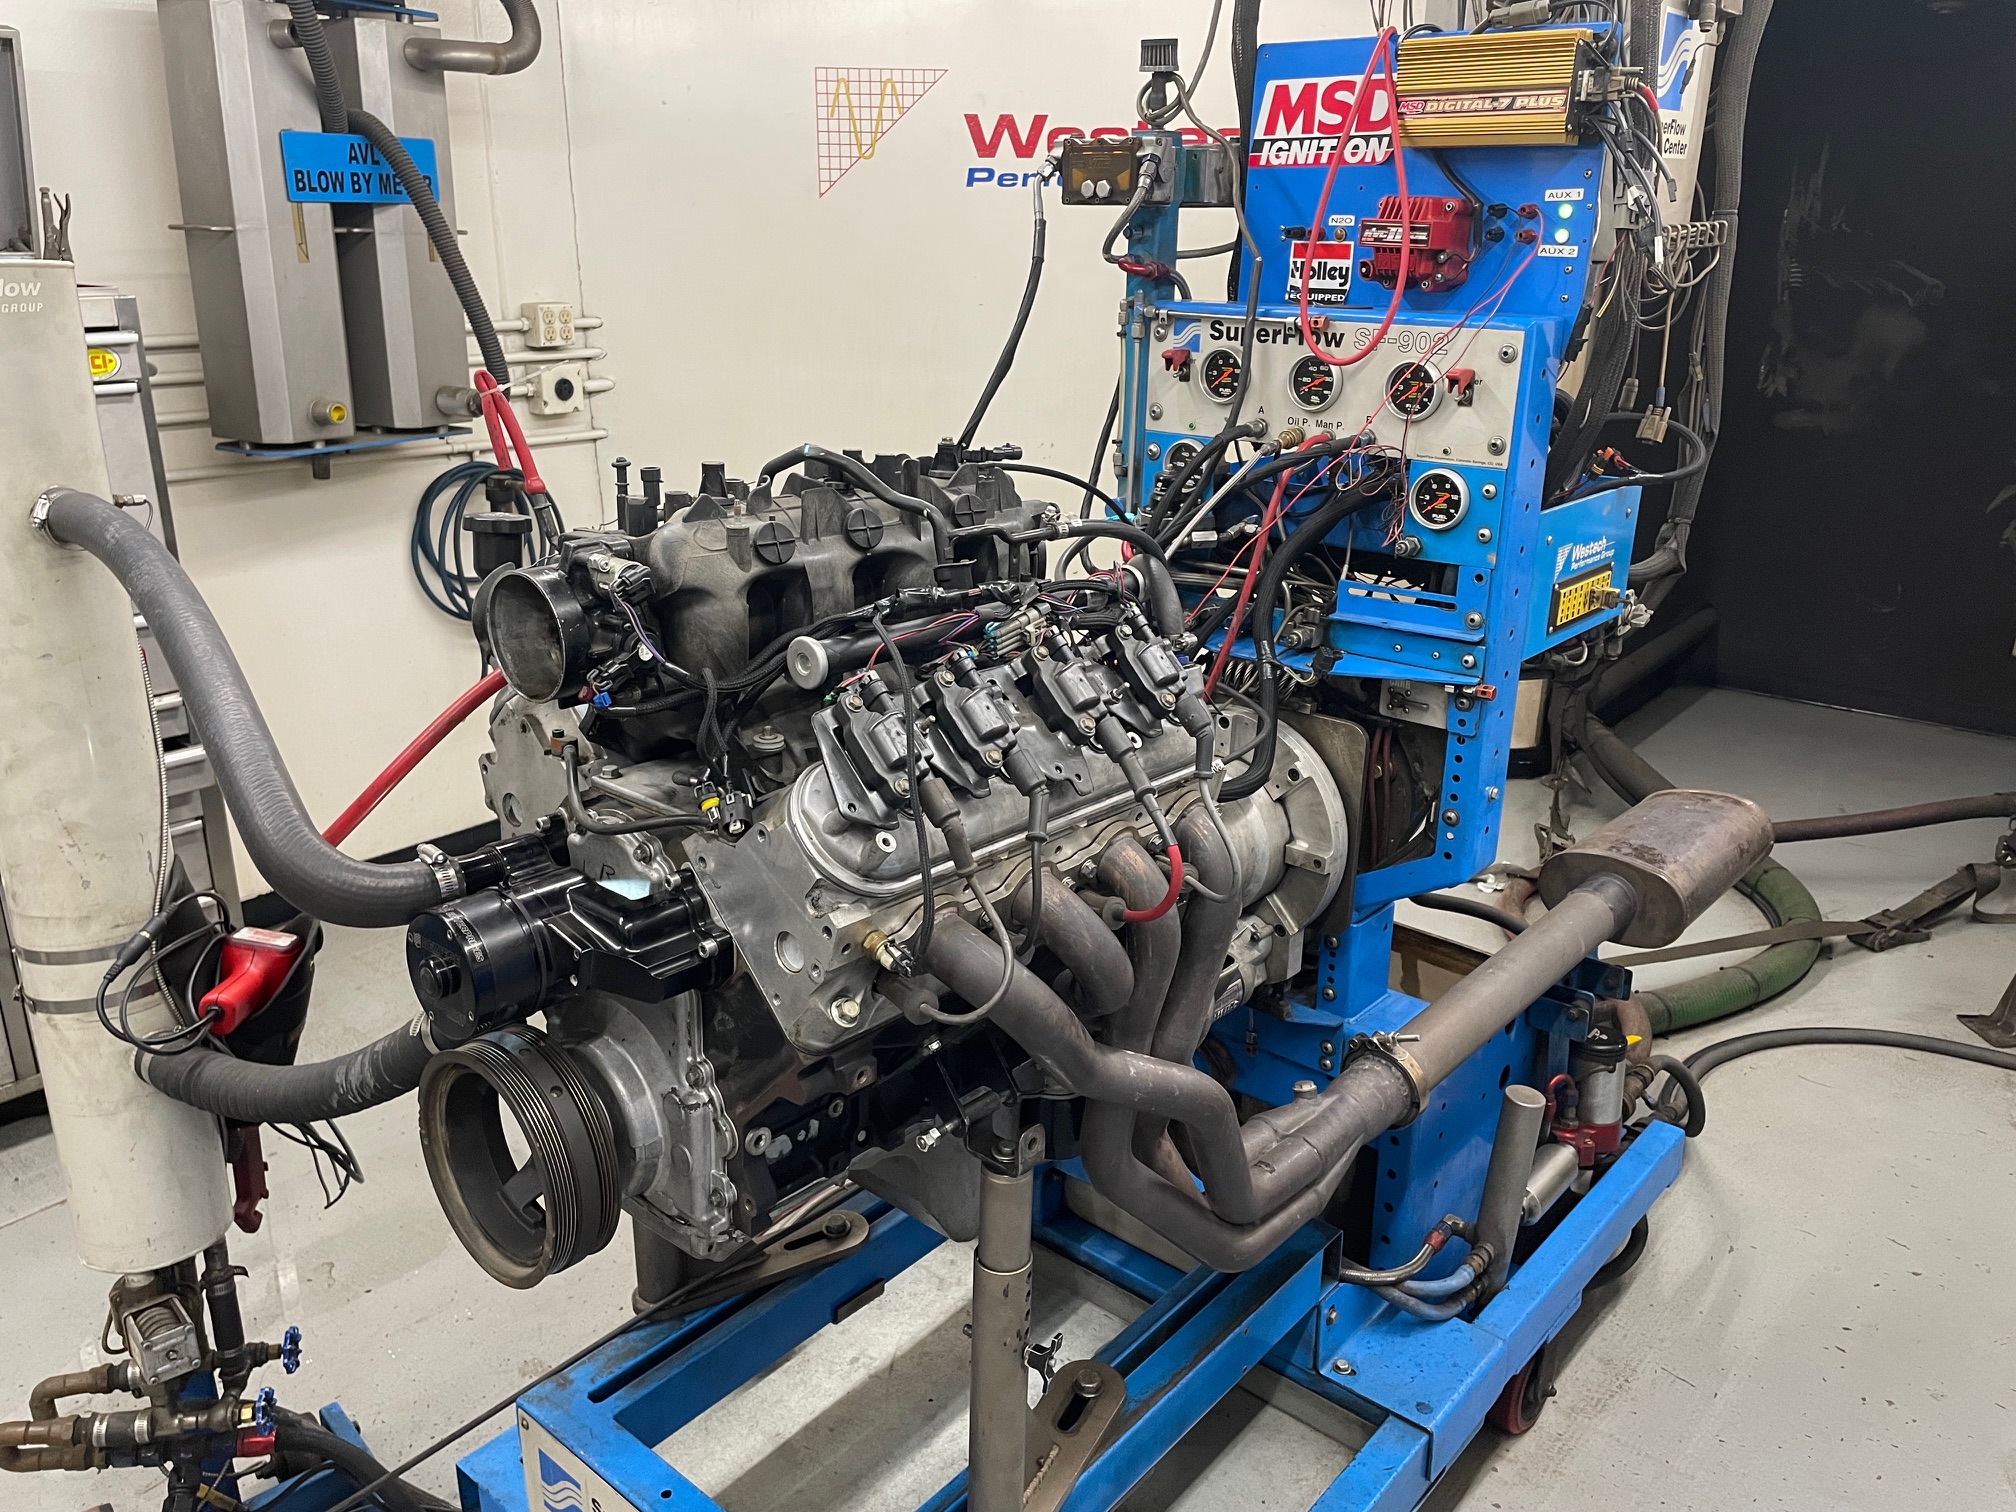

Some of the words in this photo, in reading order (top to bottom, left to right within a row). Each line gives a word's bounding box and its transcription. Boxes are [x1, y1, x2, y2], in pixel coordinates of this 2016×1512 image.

[1263, 79, 1396, 135] MSD
[1399, 101, 1424, 113] MSD
[1424, 97, 1513, 112] DIGITAL-7
[1513, 95, 1567, 109] PLUS
[348, 142, 380, 166] AVL
[1259, 137, 1389, 165] IGNITON
[1664, 138, 1687, 155] Center
[294, 169, 344, 194] BLOW
[350, 171, 372, 194] BY
[379, 173, 433, 196] MER
[1291, 260, 1350, 287] Holley
[2, 302, 44, 313] GROUP
[1353, 327, 1449, 356] SF-902
[1258, 406, 1265, 414] A
[1287, 416, 1300, 427] Oil
[1302, 418, 1311, 427] P.
[1315, 419, 1334, 430] Man
[1336, 421, 1345, 431] P.
[1572, 535, 1607, 562] Westech
